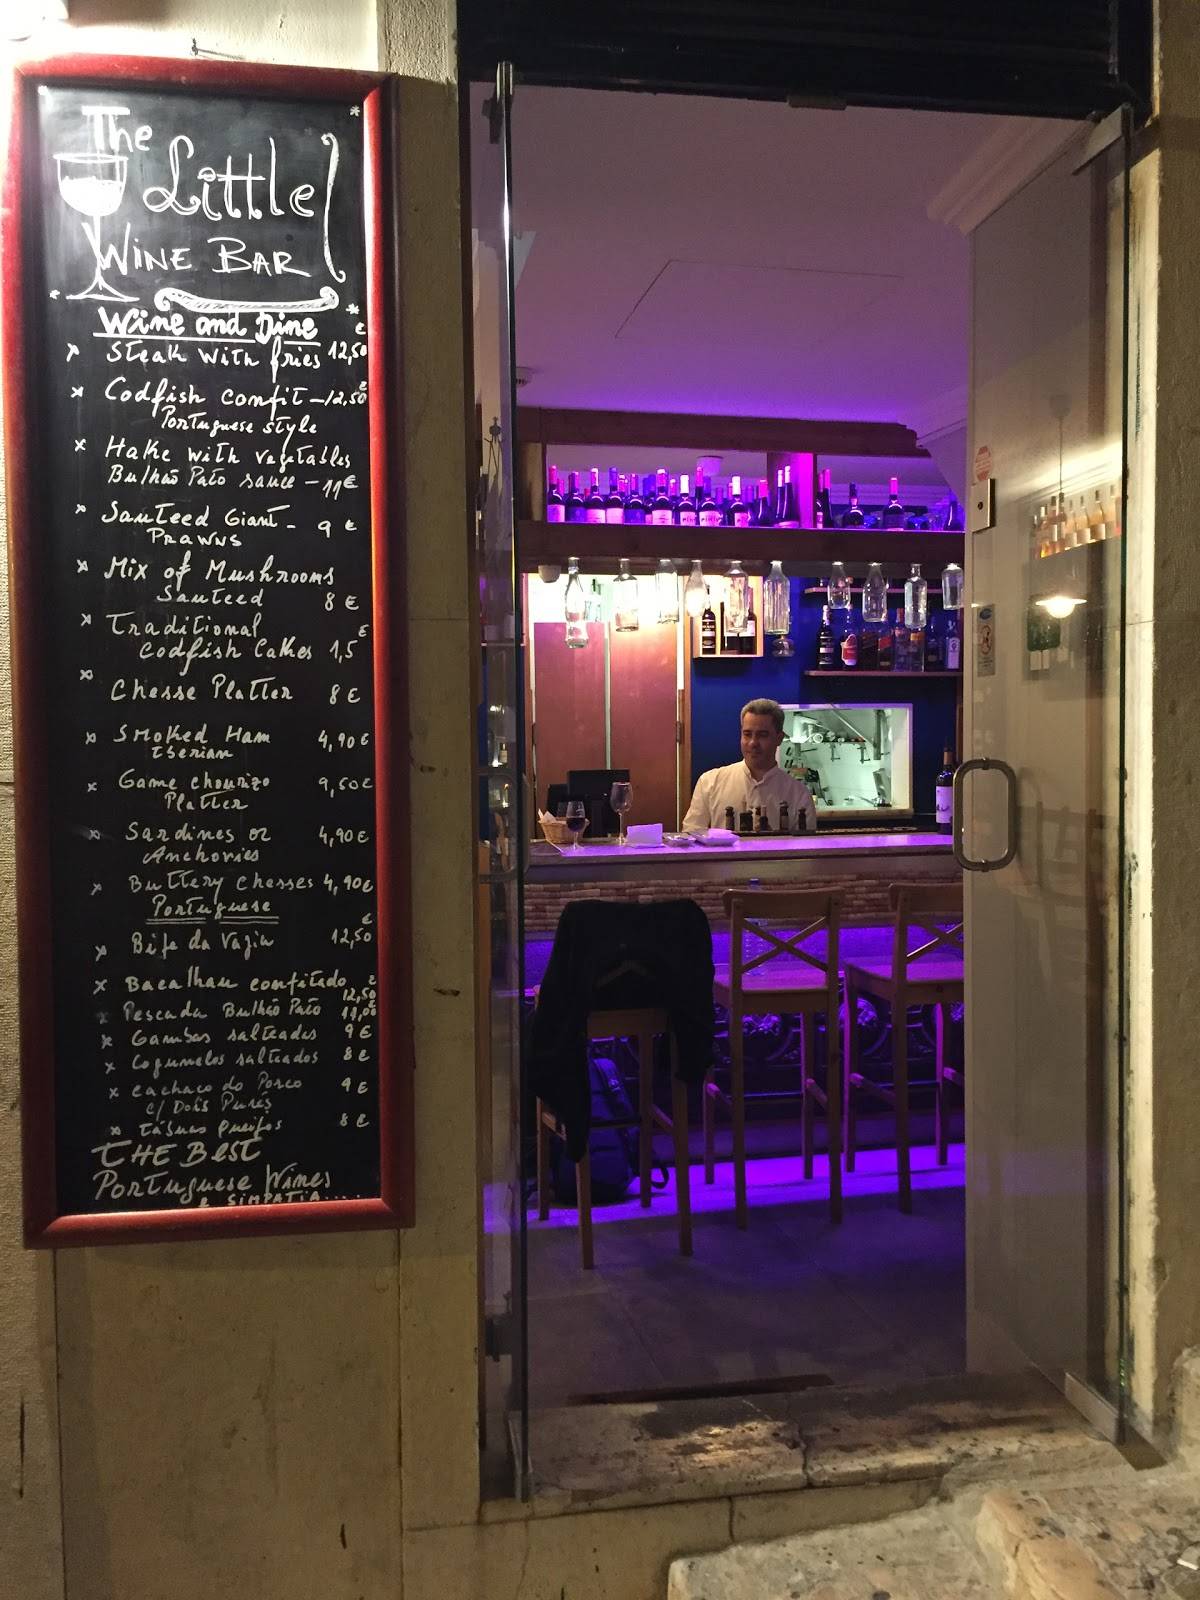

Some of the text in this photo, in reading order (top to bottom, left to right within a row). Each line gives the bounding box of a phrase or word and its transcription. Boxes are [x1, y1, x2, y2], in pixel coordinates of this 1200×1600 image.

[82, 106, 153, 152] The
[143, 135, 315, 221] Little
[98, 307, 318, 344] Wine and Dine
[106, 340, 188, 363] Steak
[270, 336, 322, 383] fries
[104, 377, 206, 417] Codfish
[161, 405, 318, 453] Portuguese style
[104, 435, 171, 462] Hake
[256, 446, 351, 474] vegetables
[188, 468, 226, 487] Pato
[240, 474, 295, 490] sauce
[101, 500, 210, 527] Sauteed
[224, 505, 291, 528] Giant
[104, 551, 335, 591] Mix of Mushrooms
[156, 585, 264, 607] Sauteed
[106, 611, 262, 638] Traditional
[139, 637, 242, 676] Codfish
[254, 636, 313, 660] Cakes
[211, 673, 294, 701] Platter
[113, 723, 208, 745] Smoked
[225, 725, 272, 744] Ham
[118, 769, 178, 790] Game
[164, 788, 249, 812] Platter
[125, 822, 235, 842] Sardines
[249, 829, 272, 842] or
[128, 870, 224, 905] Buttery
[152, 894, 272, 920] Portuguese
[125, 966, 239, 992] Bacalhau
[123, 1000, 208, 1022] Pescada
[92, 1162, 331, 1205] Portuguese Wines
